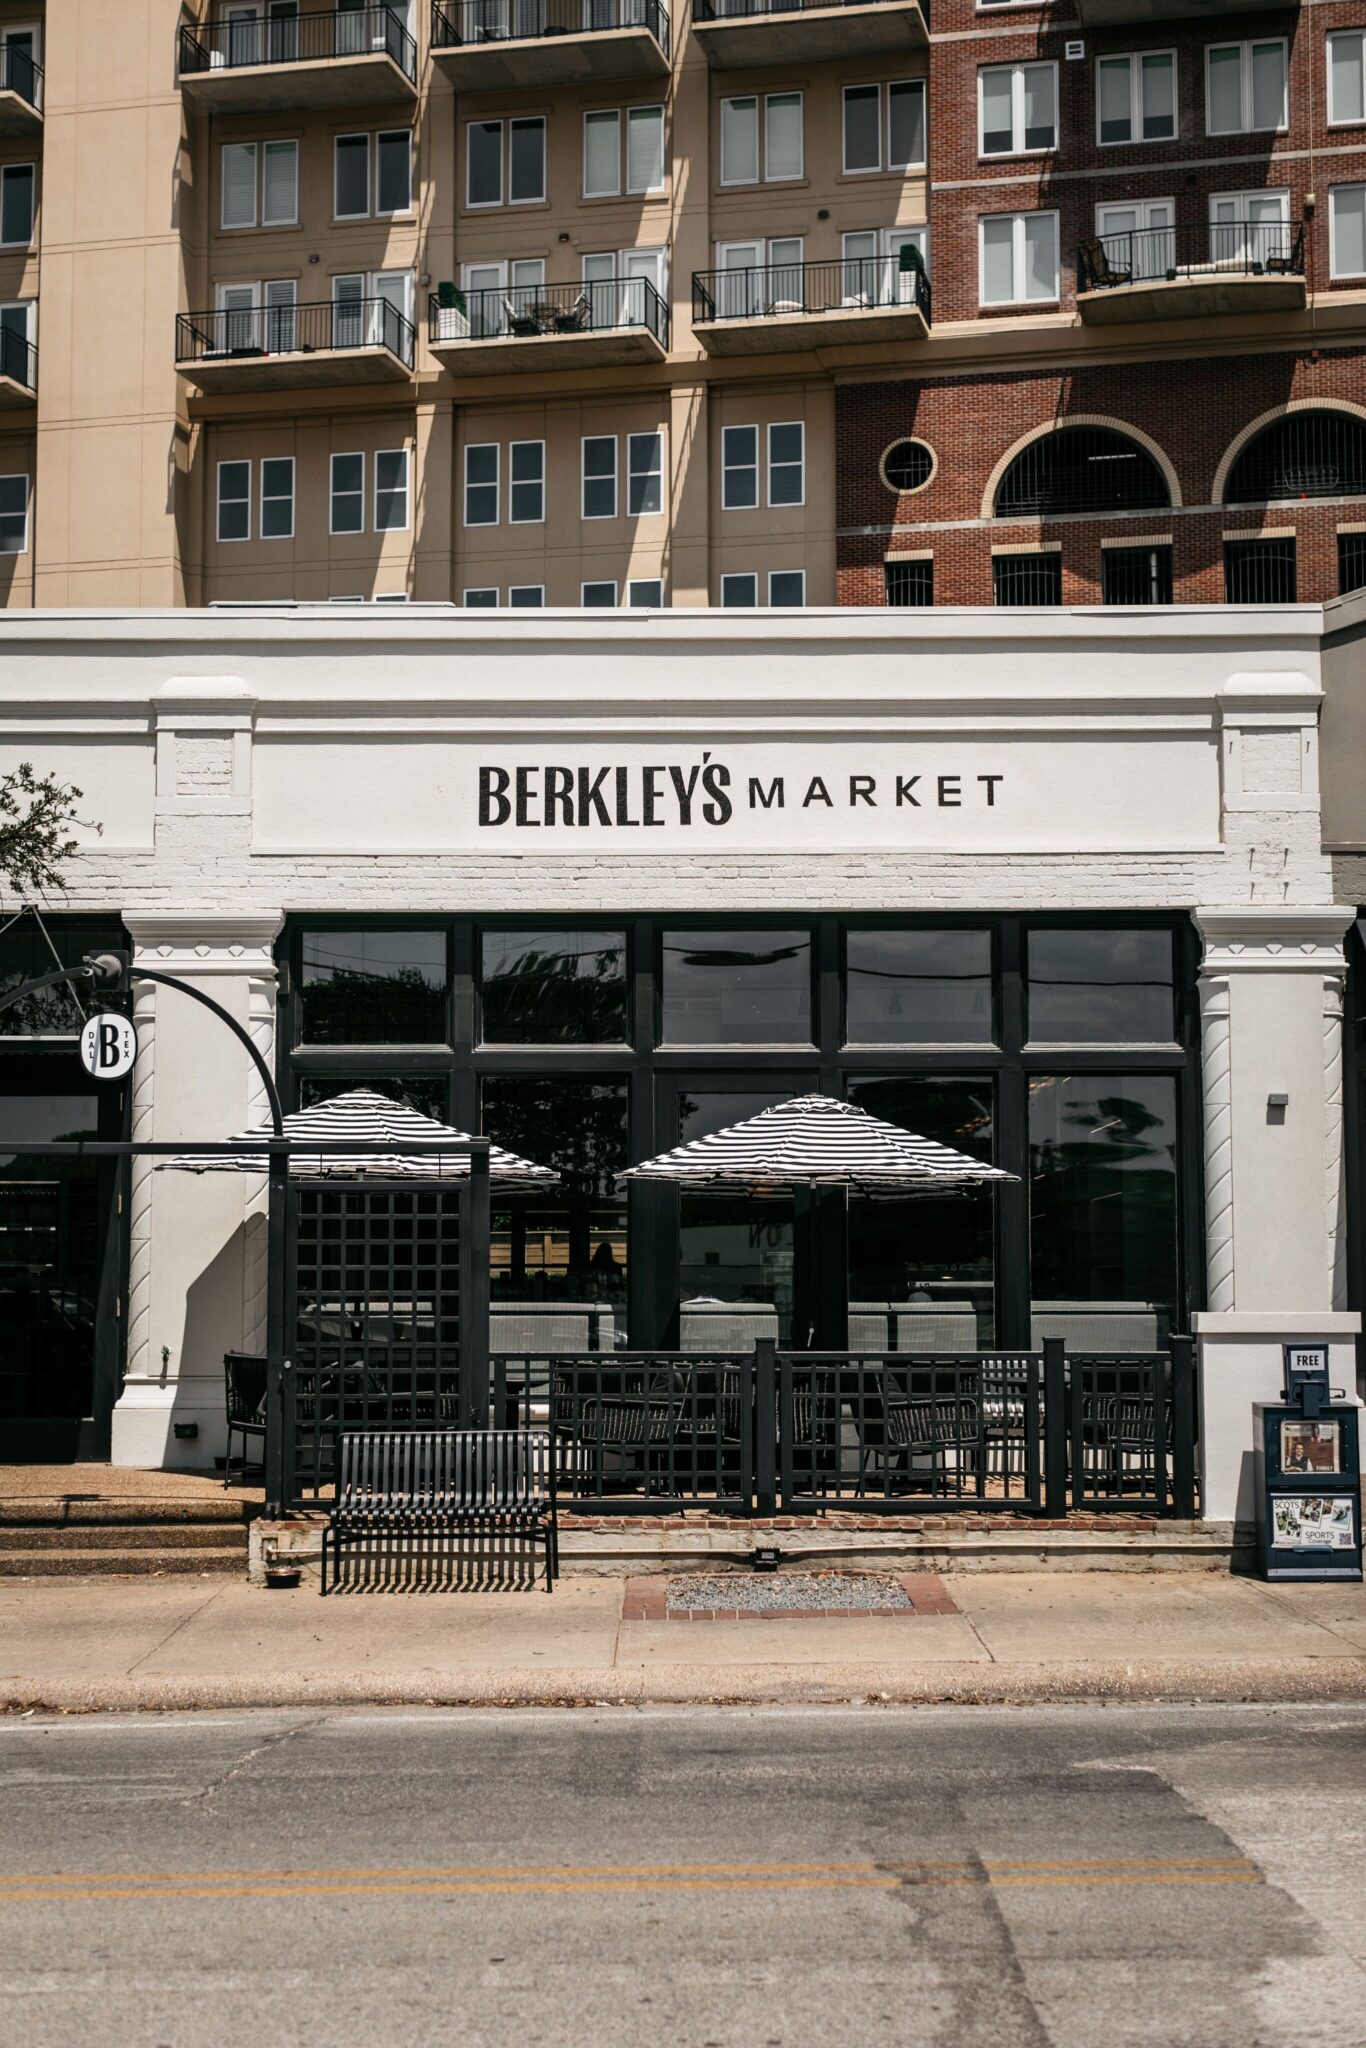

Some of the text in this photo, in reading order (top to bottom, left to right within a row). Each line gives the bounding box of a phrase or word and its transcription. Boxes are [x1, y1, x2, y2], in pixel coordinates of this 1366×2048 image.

[478, 752, 1005, 827] BERKLEY'S MARKET
[100, 1024, 120, 1068] B
[1296, 1355, 1319, 1366] FREE
[1274, 1501, 1300, 1509] SCOTS
[1305, 1531, 1335, 1539] SPORTS
